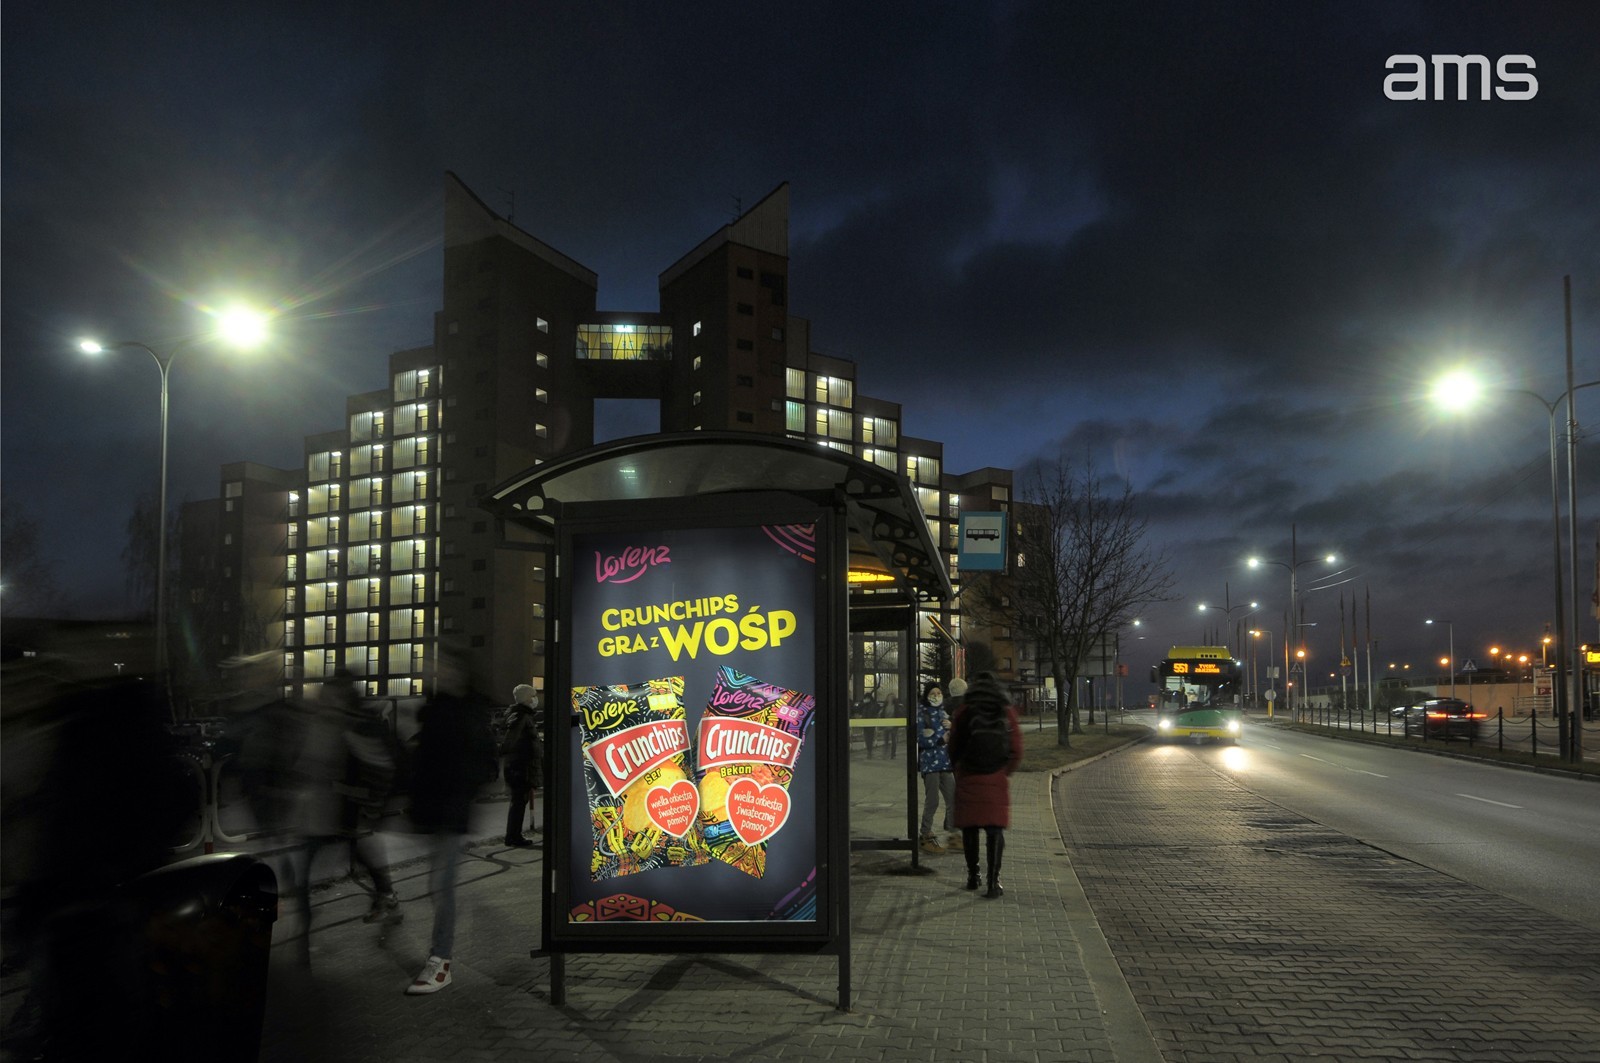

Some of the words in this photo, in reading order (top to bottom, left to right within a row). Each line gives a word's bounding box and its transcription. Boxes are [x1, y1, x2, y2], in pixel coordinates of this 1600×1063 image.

[595, 545, 672, 584] Lorenz
[601, 594, 739, 632] CRUNCHIPS
[598, 633, 648, 657] GRA
[658, 605, 797, 662] WOŚP
[713, 684, 765, 712] Lorenz
[582, 700, 640, 730] Lorenz
[605, 725, 685, 780] Crunchips
[706, 723, 792, 761] Crunchips
[644, 768, 661, 785] Ser
[720, 765, 752, 778] Bekon
[667, 815, 688, 829] pomocy
[740, 819, 768, 836] pomocy
